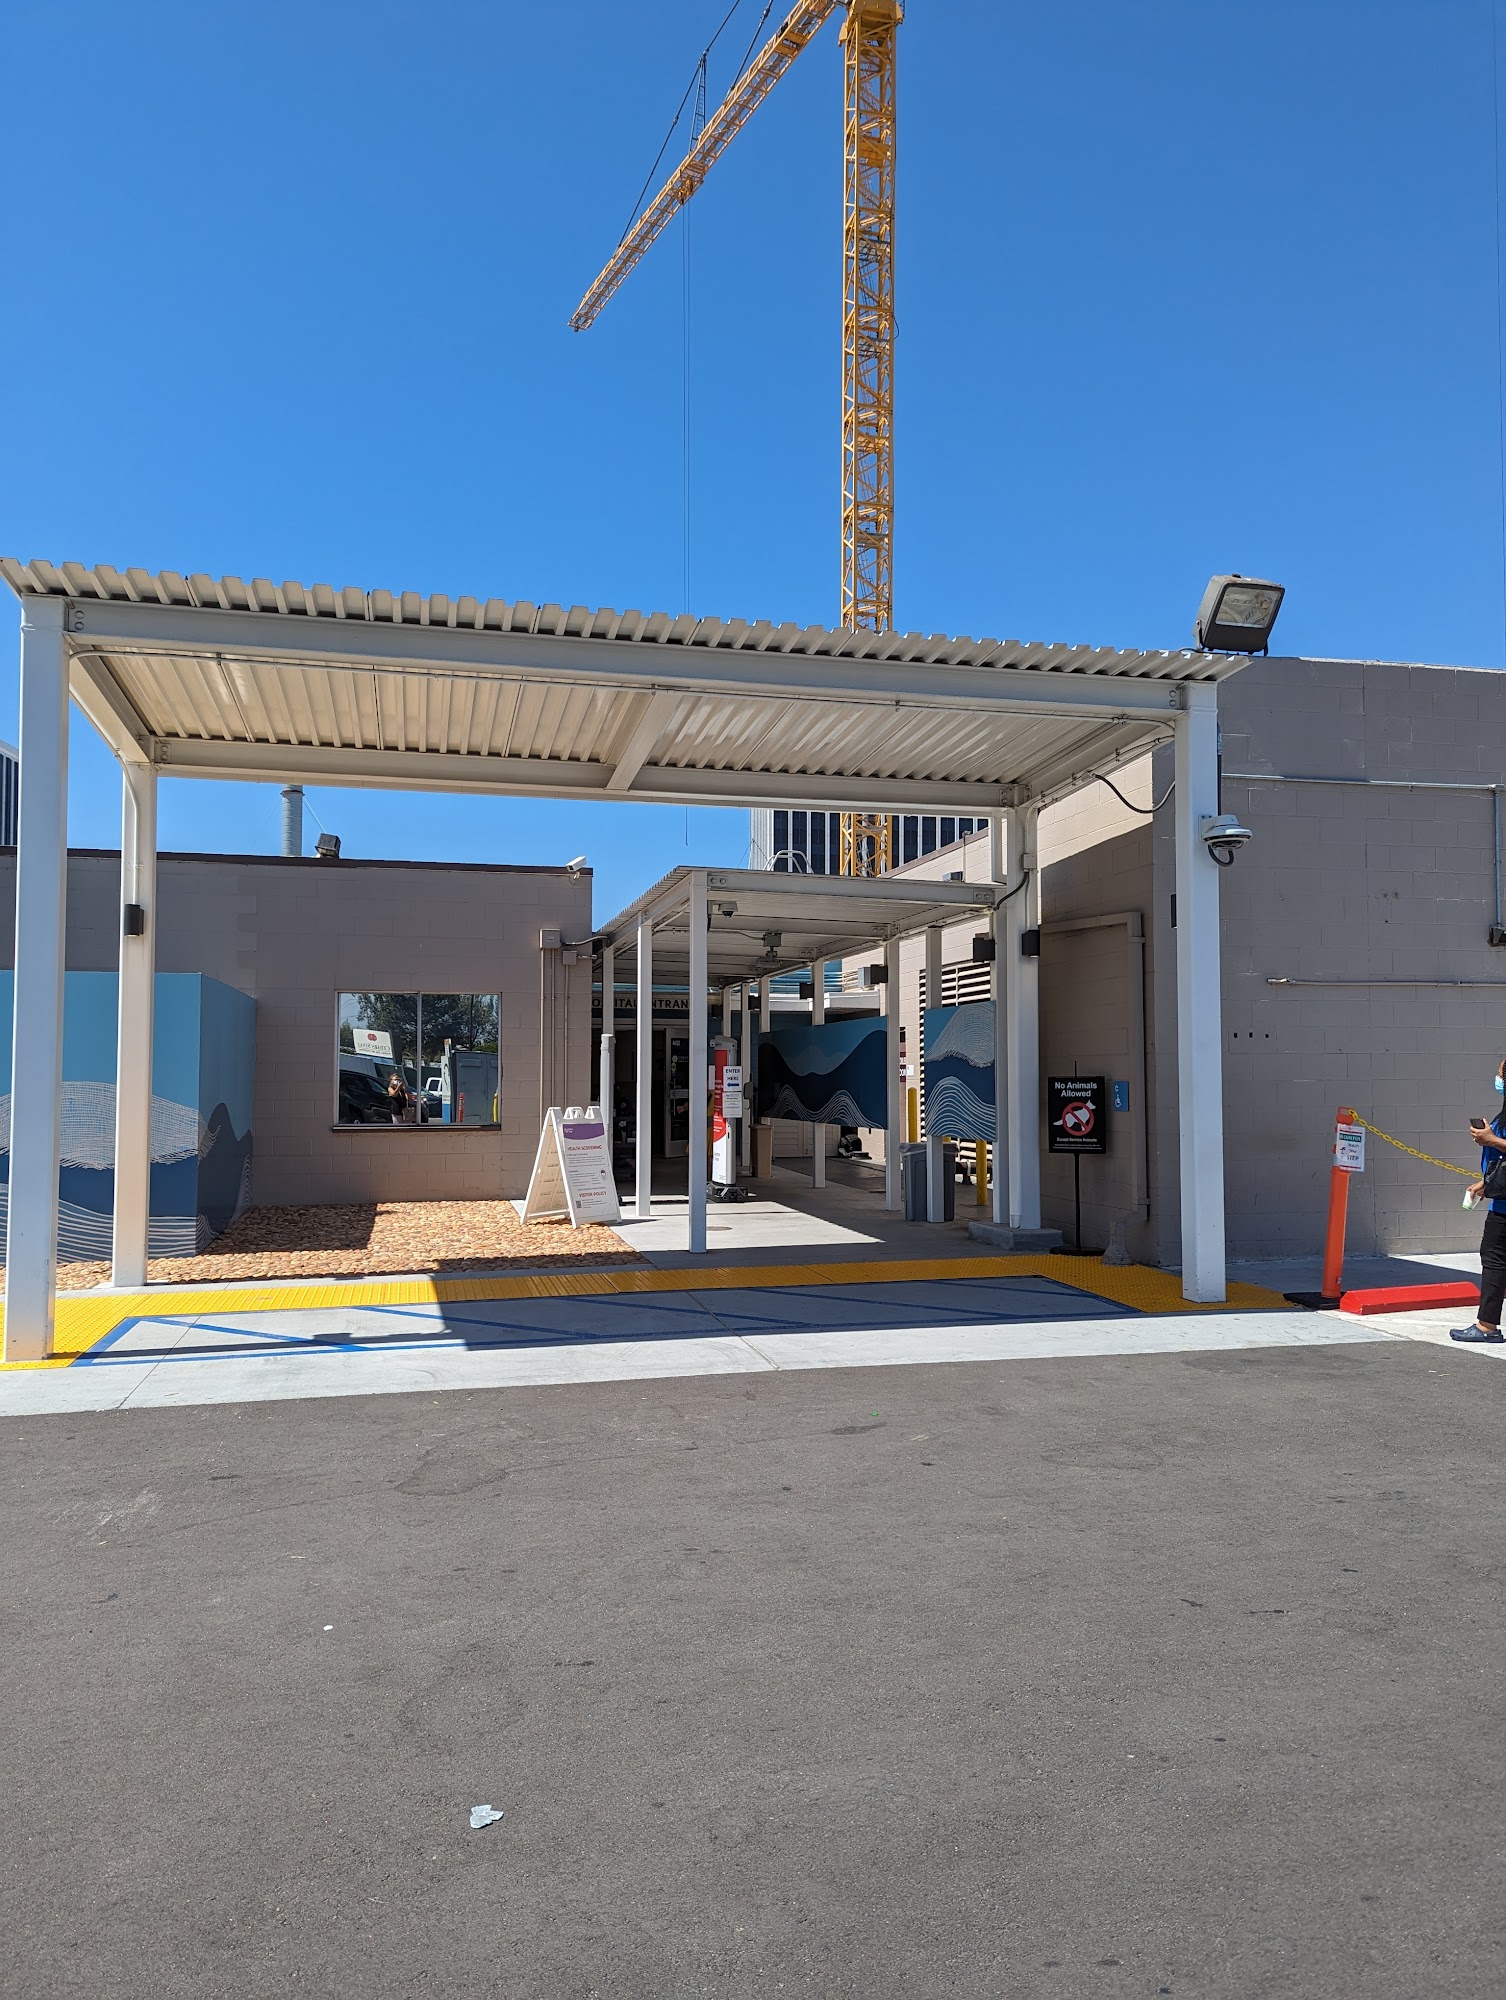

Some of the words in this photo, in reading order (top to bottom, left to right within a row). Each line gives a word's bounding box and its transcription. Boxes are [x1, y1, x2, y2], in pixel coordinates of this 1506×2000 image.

[1054, 1081, 1066, 1089] No
[1066, 1081, 1098, 1089] Animals
[1060, 1089, 1092, 1097] Allowed
